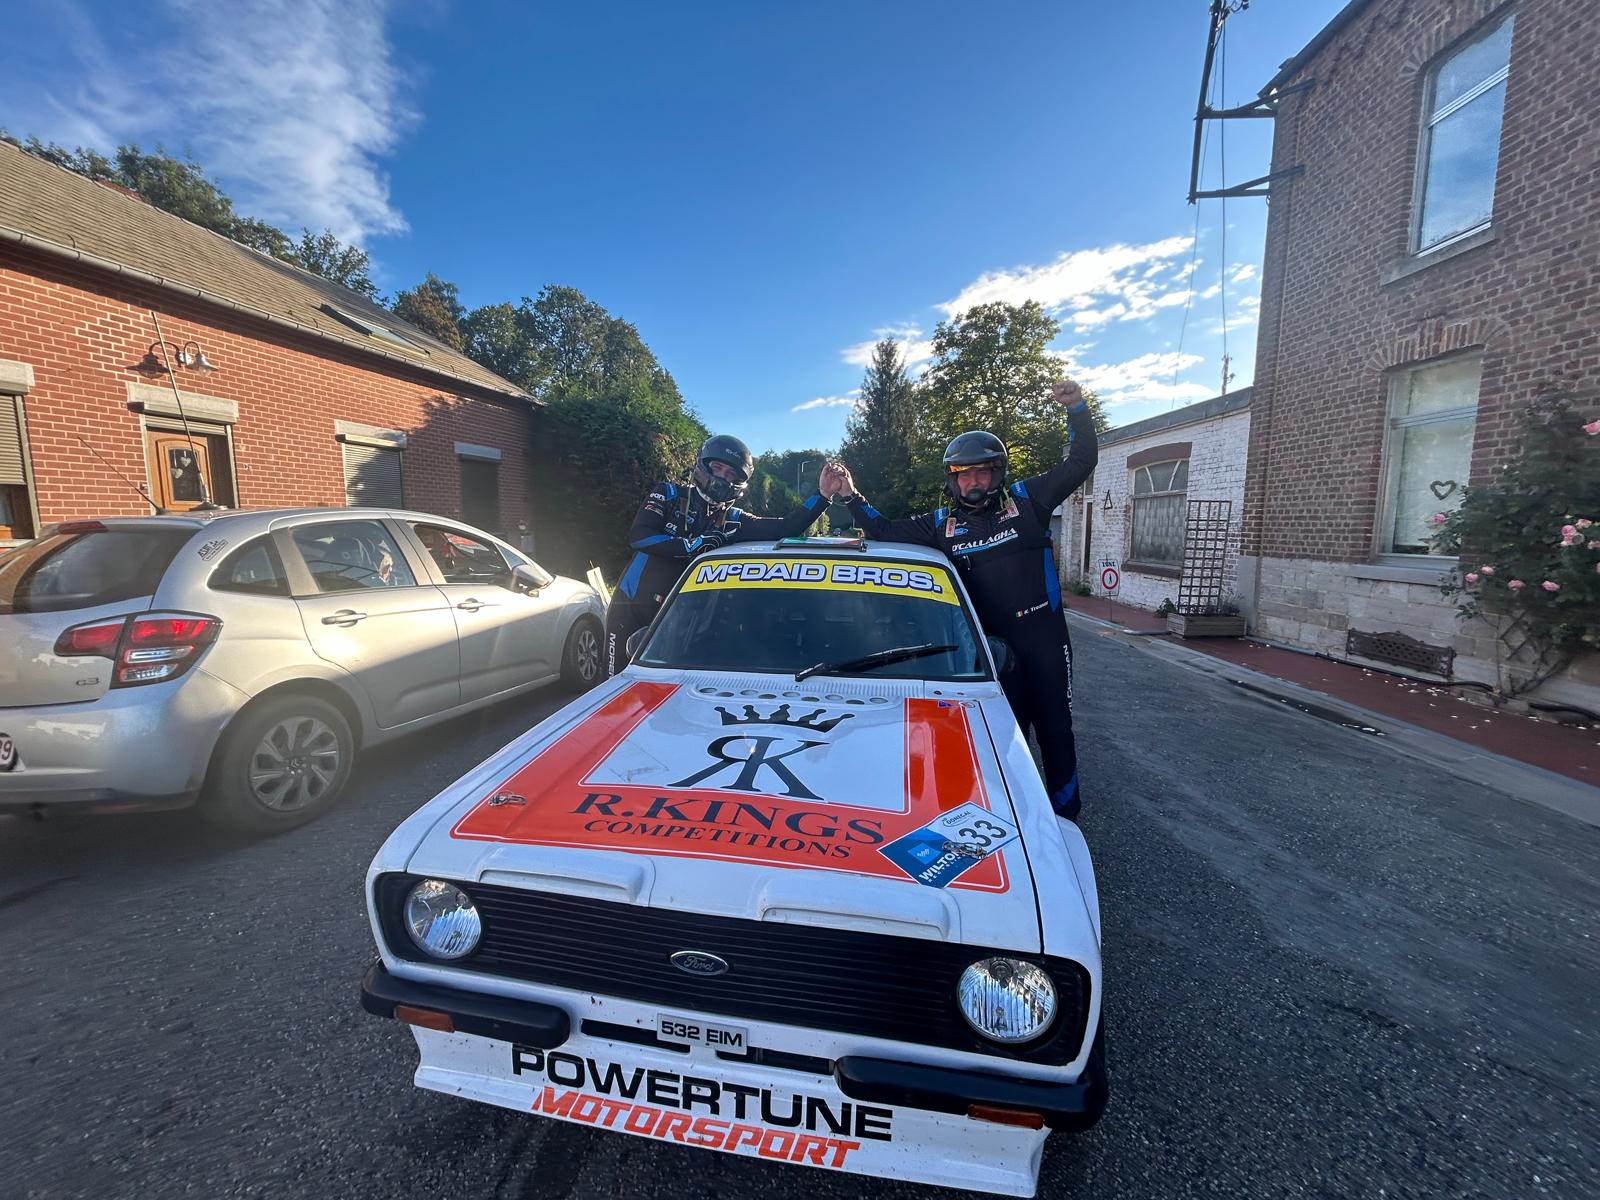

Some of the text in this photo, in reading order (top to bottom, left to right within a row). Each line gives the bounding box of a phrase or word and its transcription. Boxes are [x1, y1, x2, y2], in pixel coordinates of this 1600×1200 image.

[695, 563, 943, 594] McDAID BROS.
[75, 677, 100, 687] C3
[568, 792, 885, 845] R.KINGS
[958, 820, 1007, 848] 33
[583, 819, 852, 859] COMPETITIONS
[683, 955, 715, 971] Ford
[661, 1020, 742, 1047] 532 EIM
[511, 1042, 893, 1142] POWERTUNE
[531, 1086, 861, 1168] MOTORSPORT
